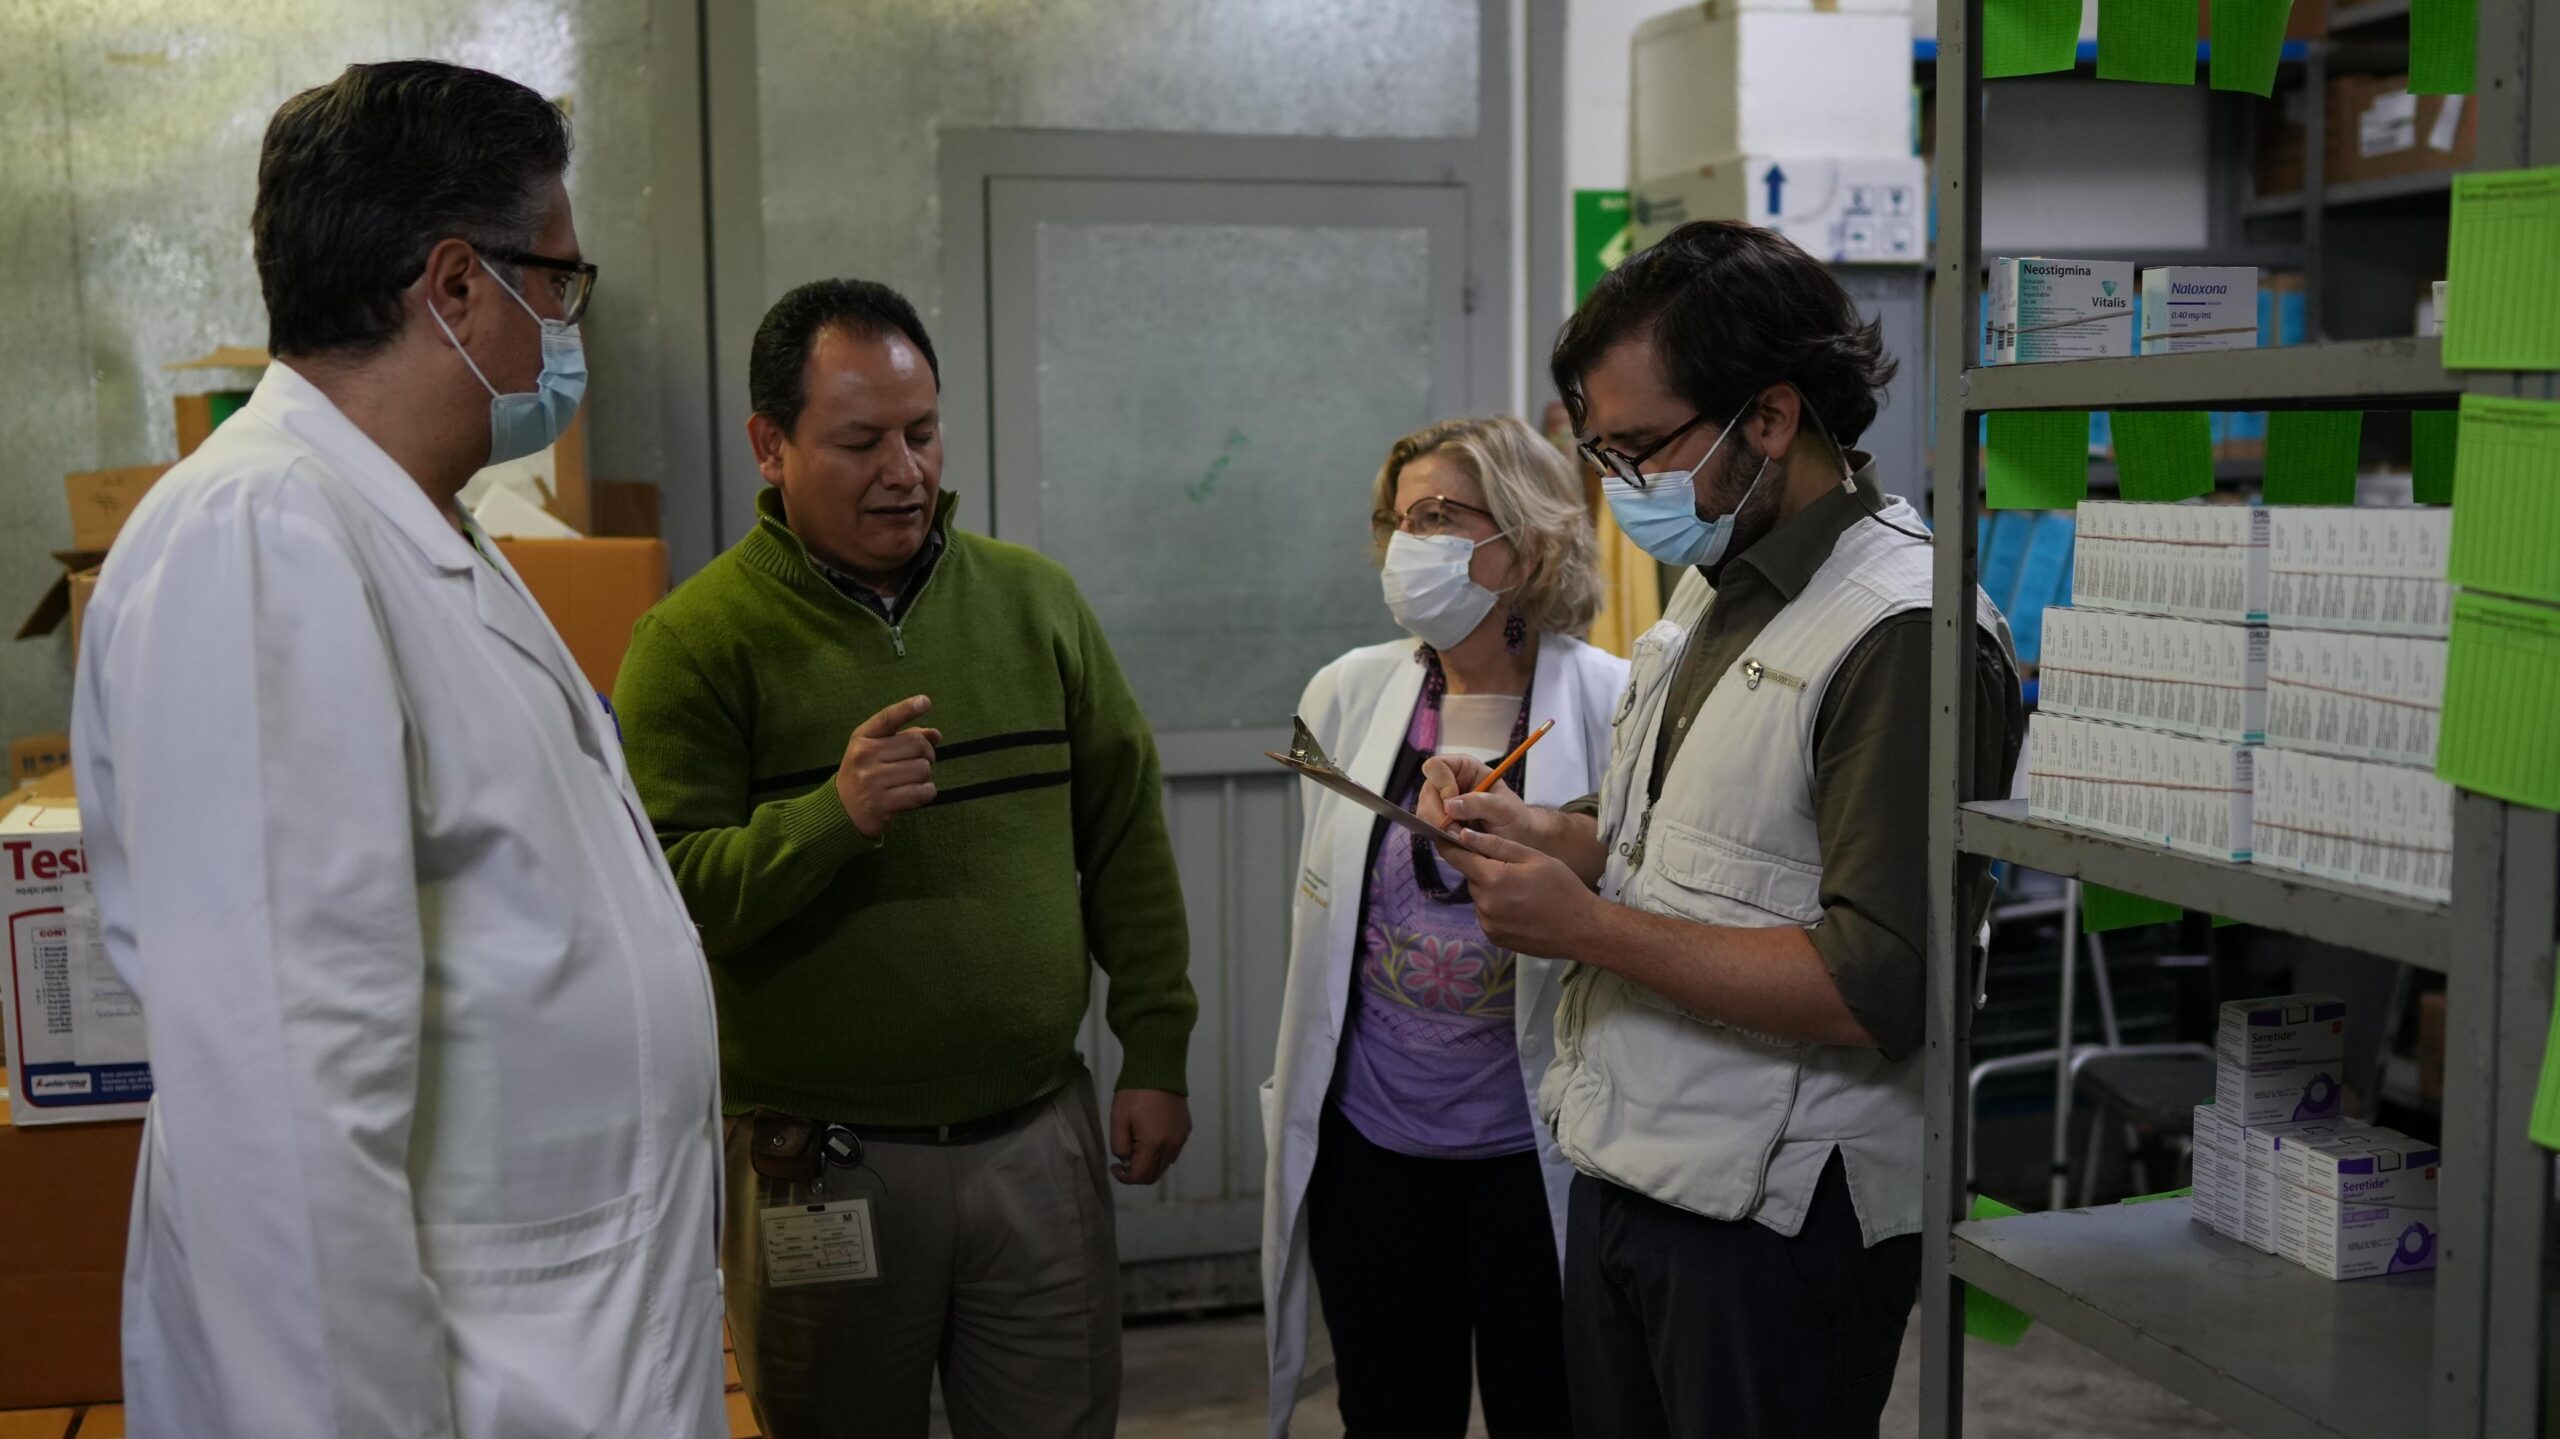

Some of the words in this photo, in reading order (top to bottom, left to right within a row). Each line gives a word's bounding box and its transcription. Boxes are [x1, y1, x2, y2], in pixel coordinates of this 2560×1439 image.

[2023, 264, 2092, 278] Neostigmina
[2171, 282, 2228, 295] Naloxona
[2091, 296, 2127, 309] Vitalis
